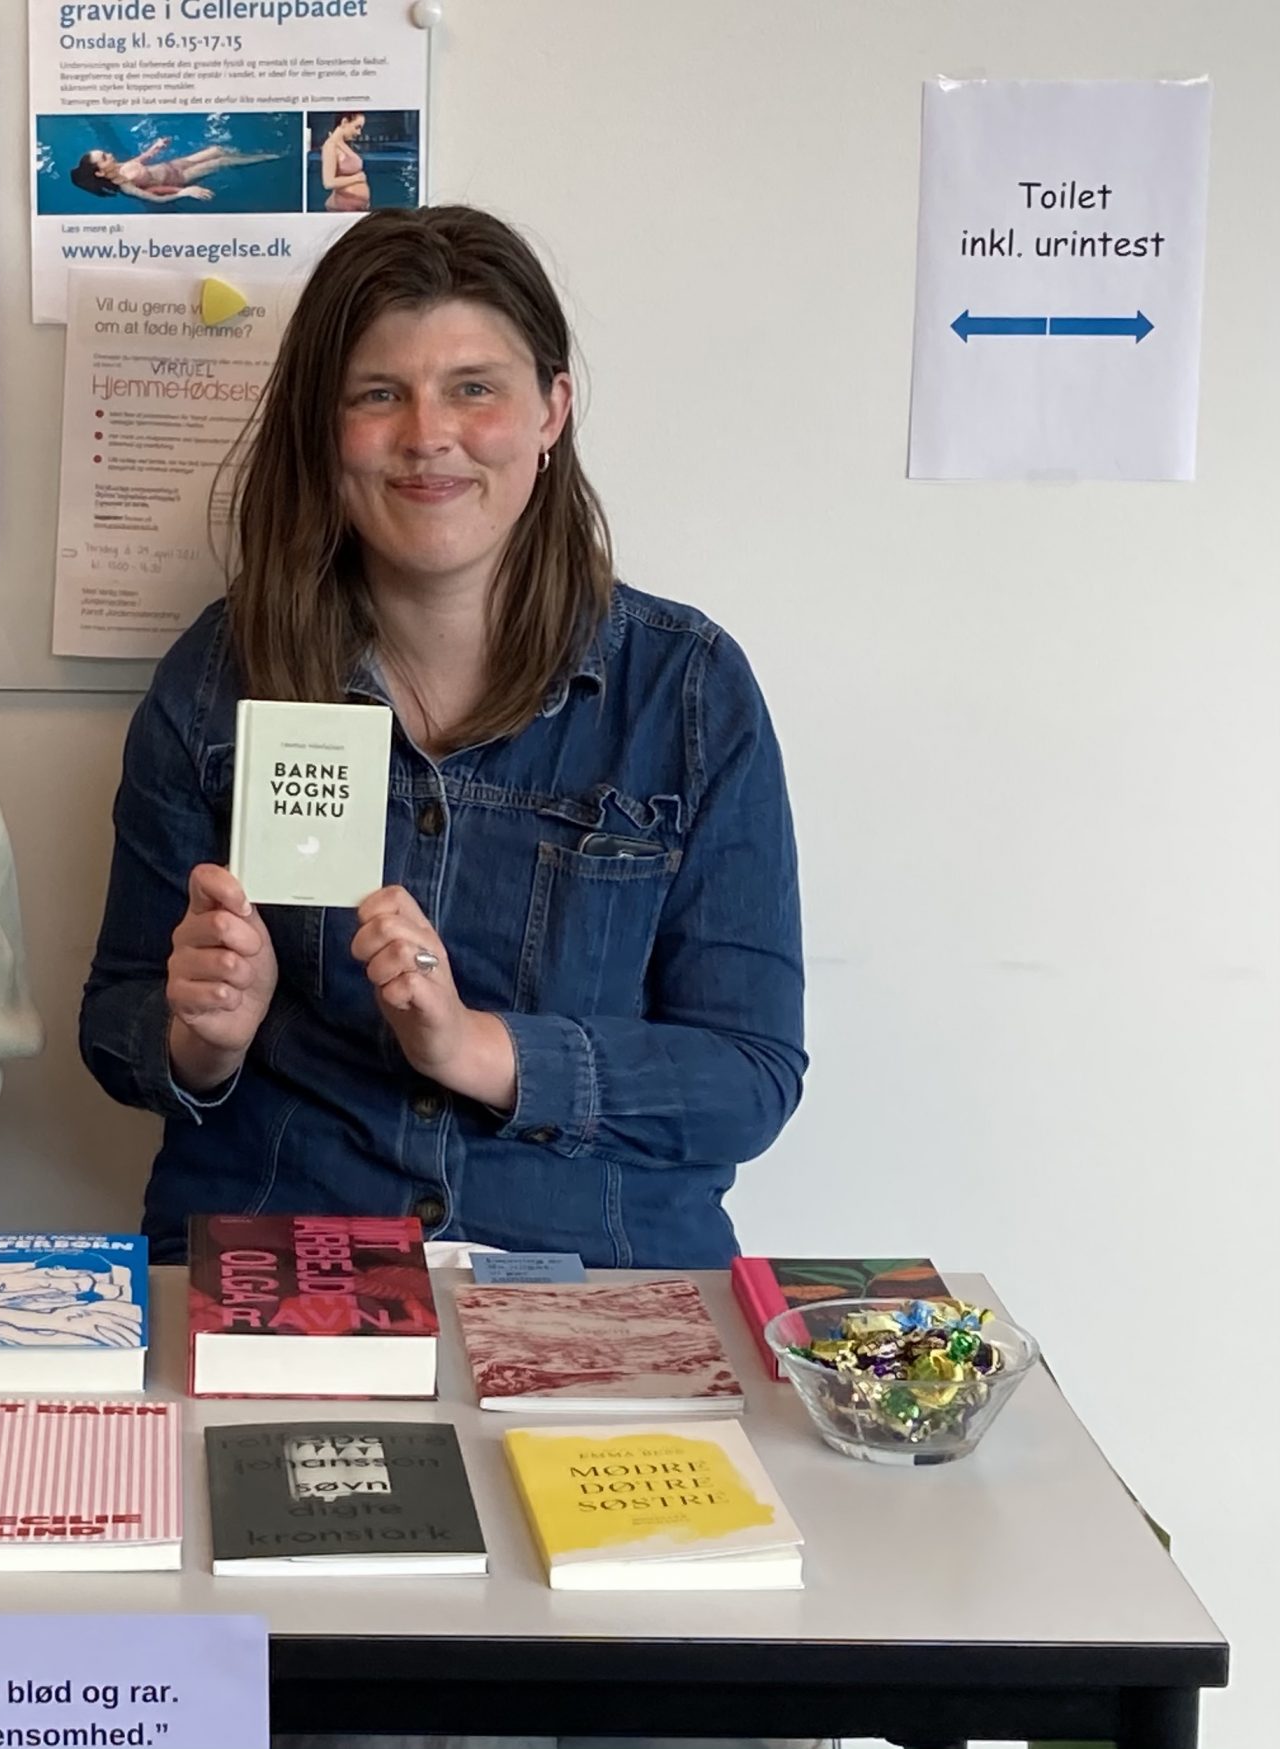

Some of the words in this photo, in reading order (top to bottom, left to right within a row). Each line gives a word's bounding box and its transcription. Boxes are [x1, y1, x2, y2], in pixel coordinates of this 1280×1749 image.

[60, 0, 155, 28] gravide
[180, 0, 368, 25] Gellerupbadet
[60, 34, 126, 53] Onsdag
[132, 33, 151, 48] kl.
[157, 33, 242, 52] 16.15-17.15
[1019, 181, 1112, 210] Toilet
[61, 224, 79, 233] Læs
[83, 225, 107, 233] mere
[61, 239, 291, 263] www.by-bevaegelse.dk
[961, 228, 1022, 258] inkl.
[1035, 231, 1164, 258] urintest
[96, 298, 113, 312] Vil
[119, 299, 137, 313] du
[142, 302, 186, 317] gerne
[95, 322, 119, 333] om
[124, 322, 138, 334] at
[144, 322, 178, 335] føde
[183, 323, 253, 340] hjemme?
[275, 762, 348, 780] BARNE
[271, 781, 349, 799] VOGNS
[274, 800, 344, 818] HAIKU
[221, 1250, 279, 1305] OLGA
[223, 1307, 391, 1329] RAVN
[37, 1404, 167, 1415] BARN
[234, 1456, 440, 1475] johansson
[570, 1461, 710, 1477] MØDRE
[295, 1480, 388, 1492] søvn
[580, 1477, 714, 1494] DØTRE
[288, 1501, 403, 1518] digte
[578, 1493, 730, 1512] SØSTRE
[7, 1680, 72, 1705] blød
[82, 1686, 119, 1709] og
[129, 1685, 179, 1704] rar.
